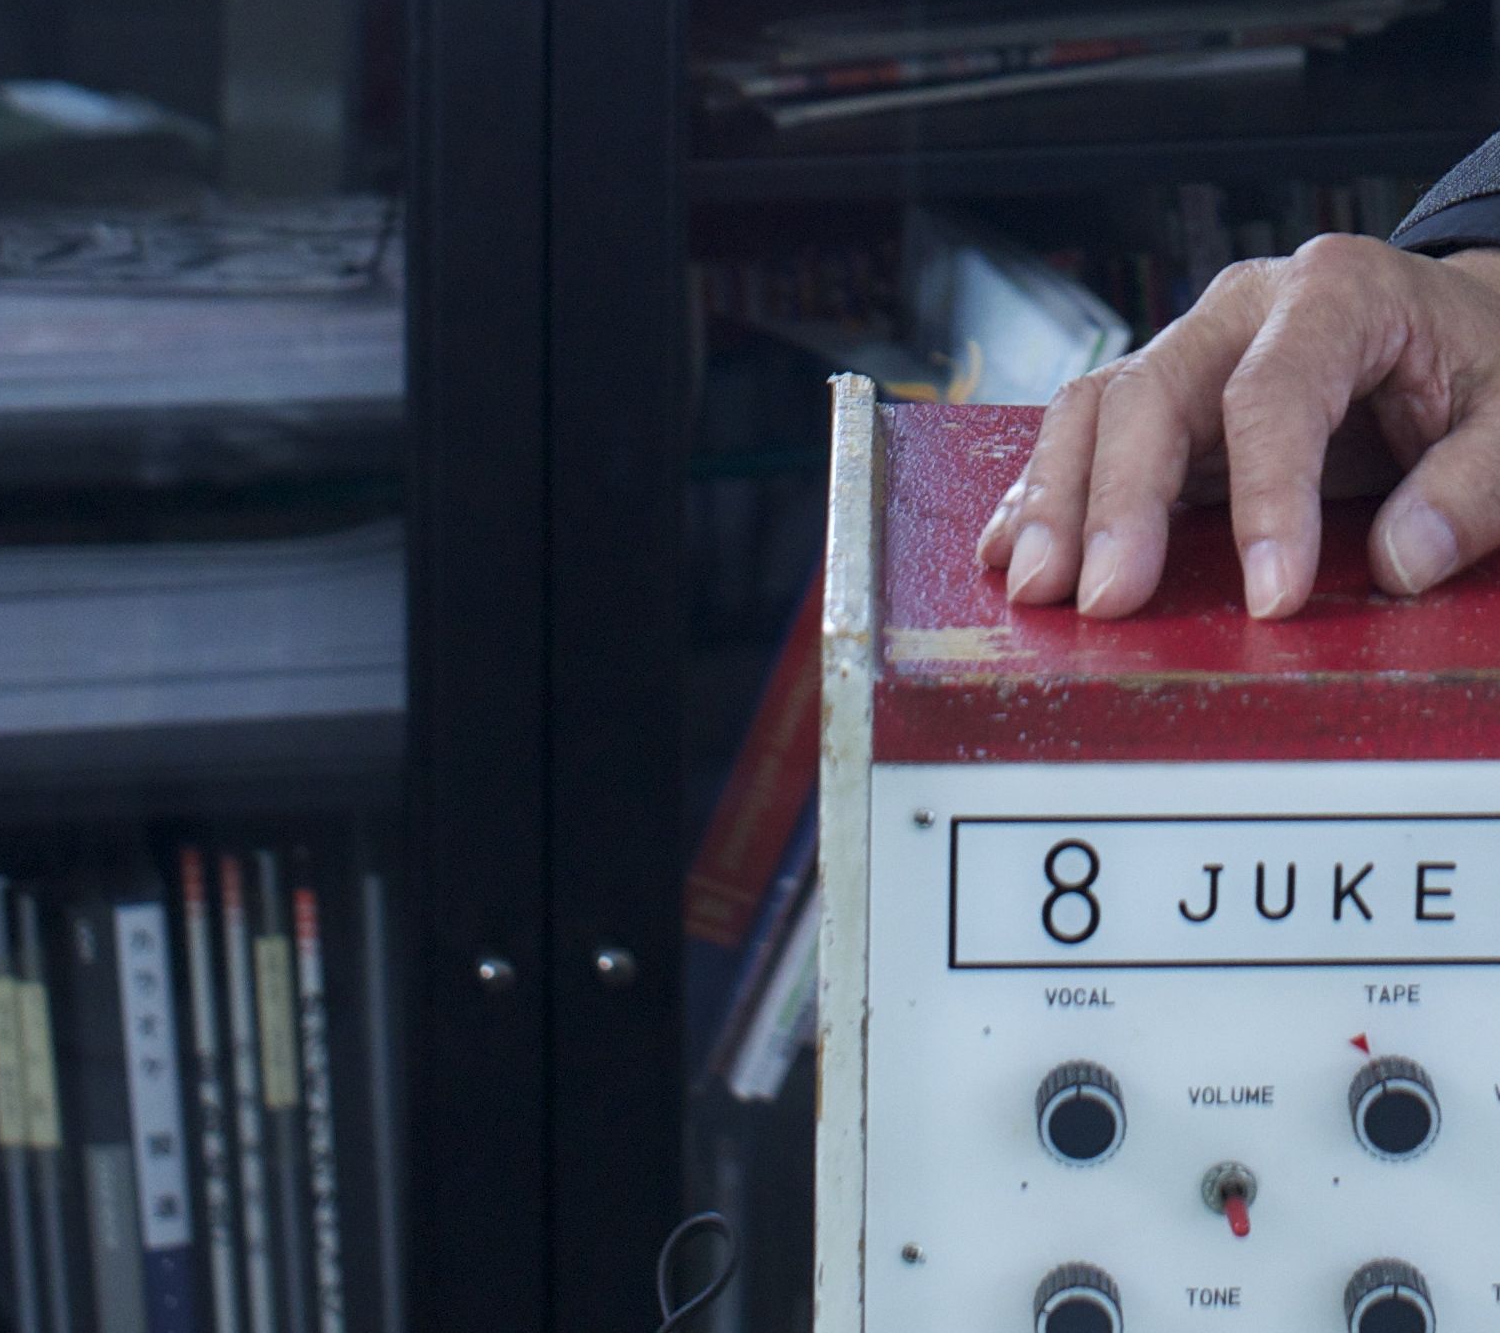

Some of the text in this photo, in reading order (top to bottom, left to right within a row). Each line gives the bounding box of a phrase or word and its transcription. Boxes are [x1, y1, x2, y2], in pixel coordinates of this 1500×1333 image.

[1041, 838, 1459, 945] 8 JUKE
[1044, 987, 1116, 1009] VOCAL
[1364, 984, 1421, 1006] TAPE
[1187, 1085, 1276, 1107] VOLUME
[1186, 1287, 1242, 1309] TONE
